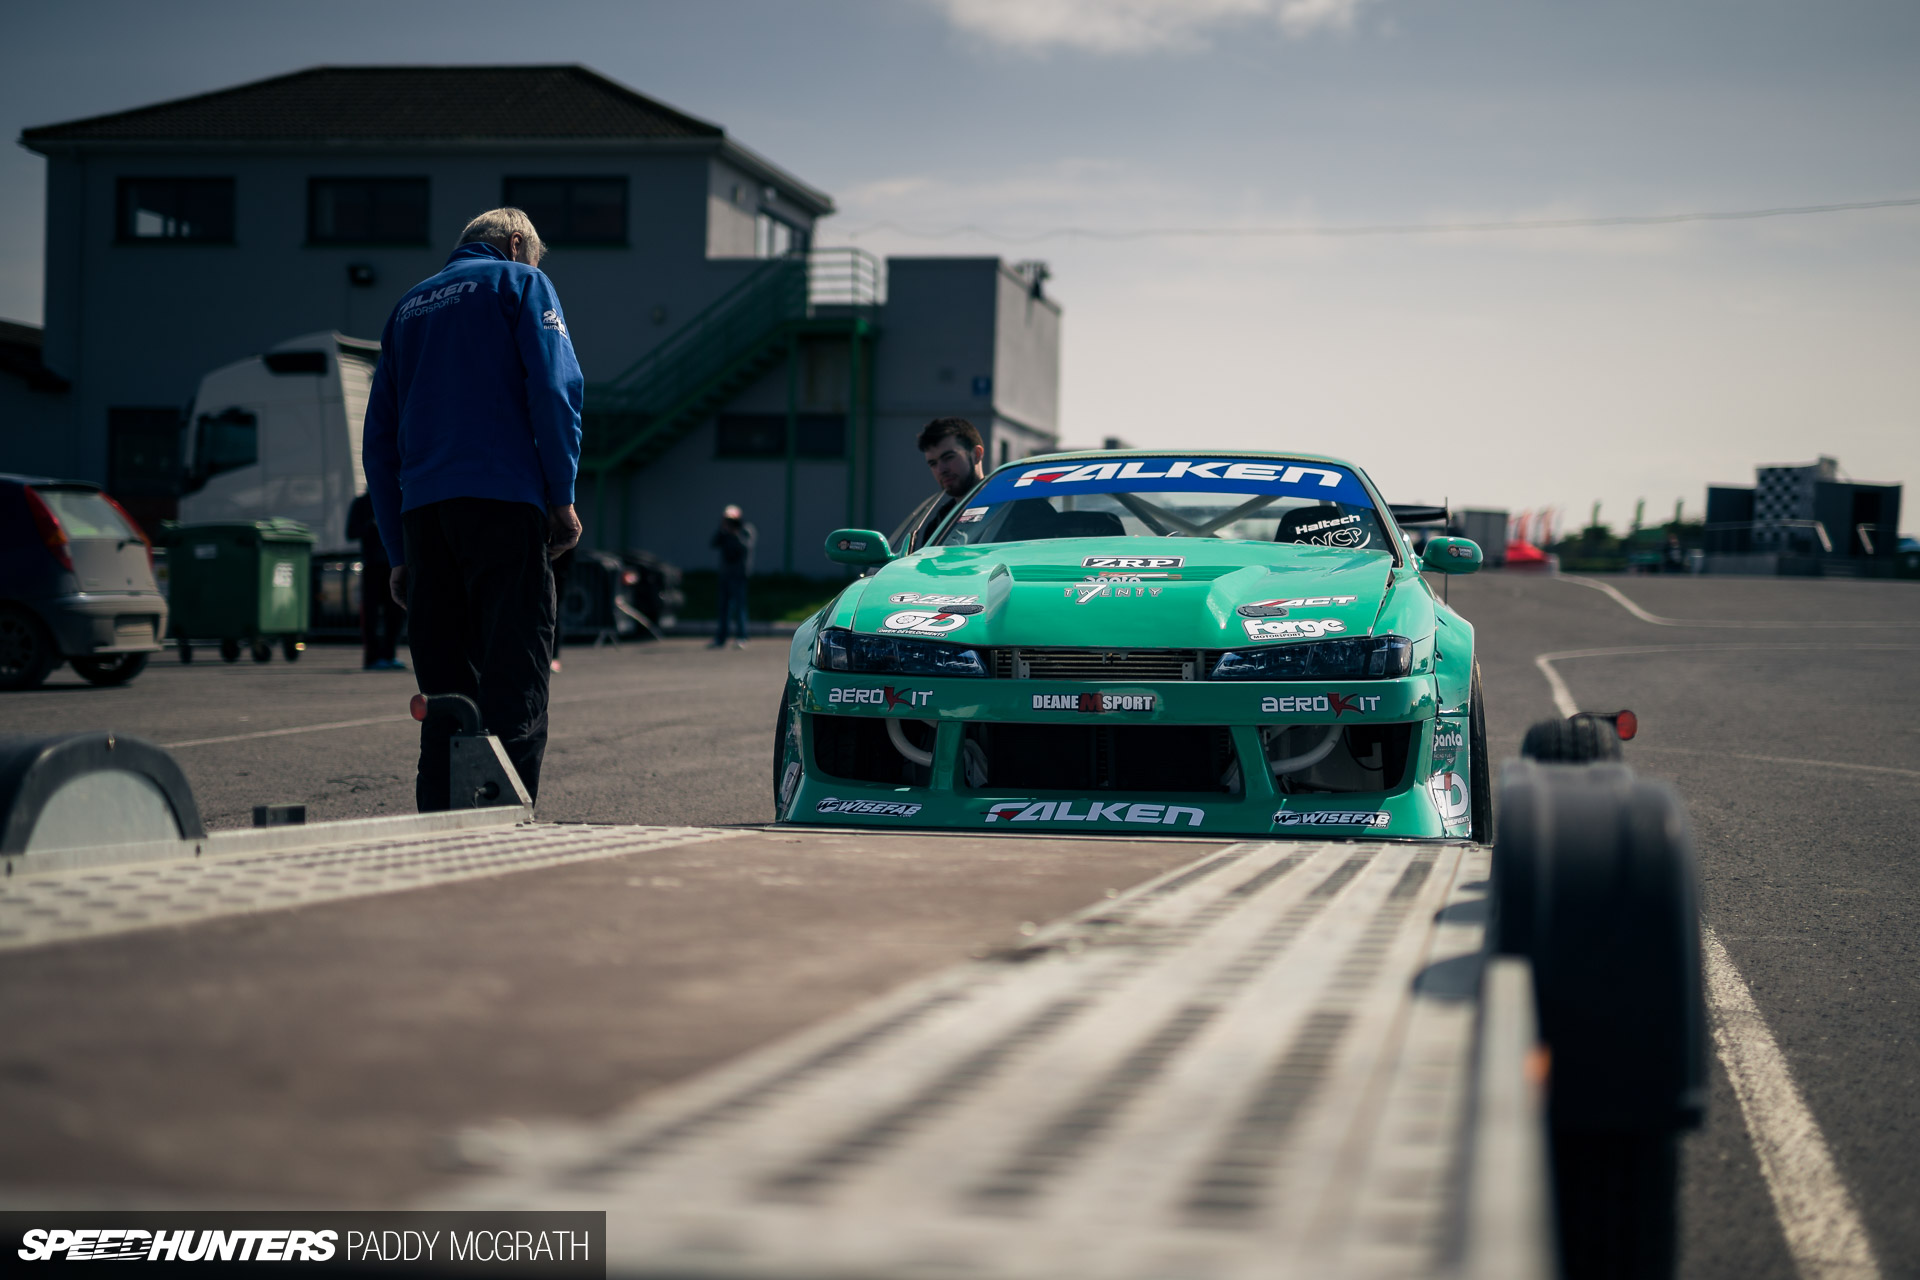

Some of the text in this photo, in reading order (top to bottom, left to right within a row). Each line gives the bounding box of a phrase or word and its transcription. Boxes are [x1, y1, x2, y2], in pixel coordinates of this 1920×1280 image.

[1013, 461, 1343, 488] FALKEN
[1295, 514, 1361, 535] Haltech
[1090, 558, 1175, 568] ZRP
[1243, 619, 1345, 638] Forge
[838, 801, 922, 815] WISEFAB
[984, 801, 1205, 826] FALKEN
[1302, 812, 1390, 825] WISEFAB
